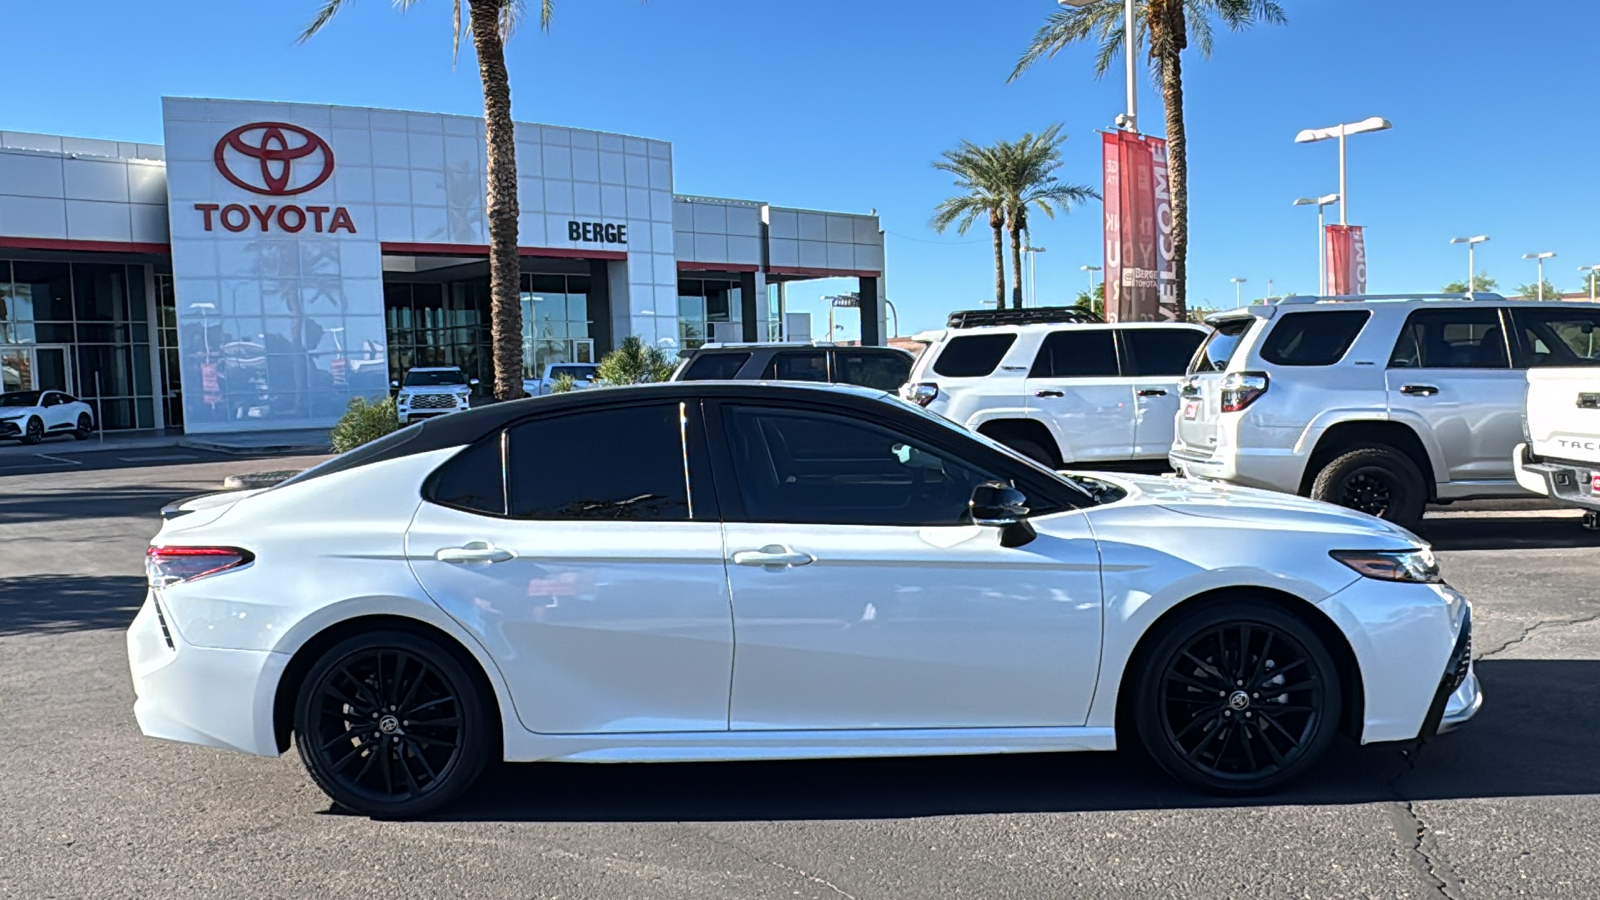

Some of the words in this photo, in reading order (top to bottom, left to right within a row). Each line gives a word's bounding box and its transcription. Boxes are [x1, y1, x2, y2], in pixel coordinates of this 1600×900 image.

[194, 203, 357, 234] TOYOTA
[568, 220, 628, 245] BERGE
[1134, 267, 1159, 280] BERGE
[1135, 279, 1159, 288] TOYOTA
[1558, 439, 1600, 451] TAC
